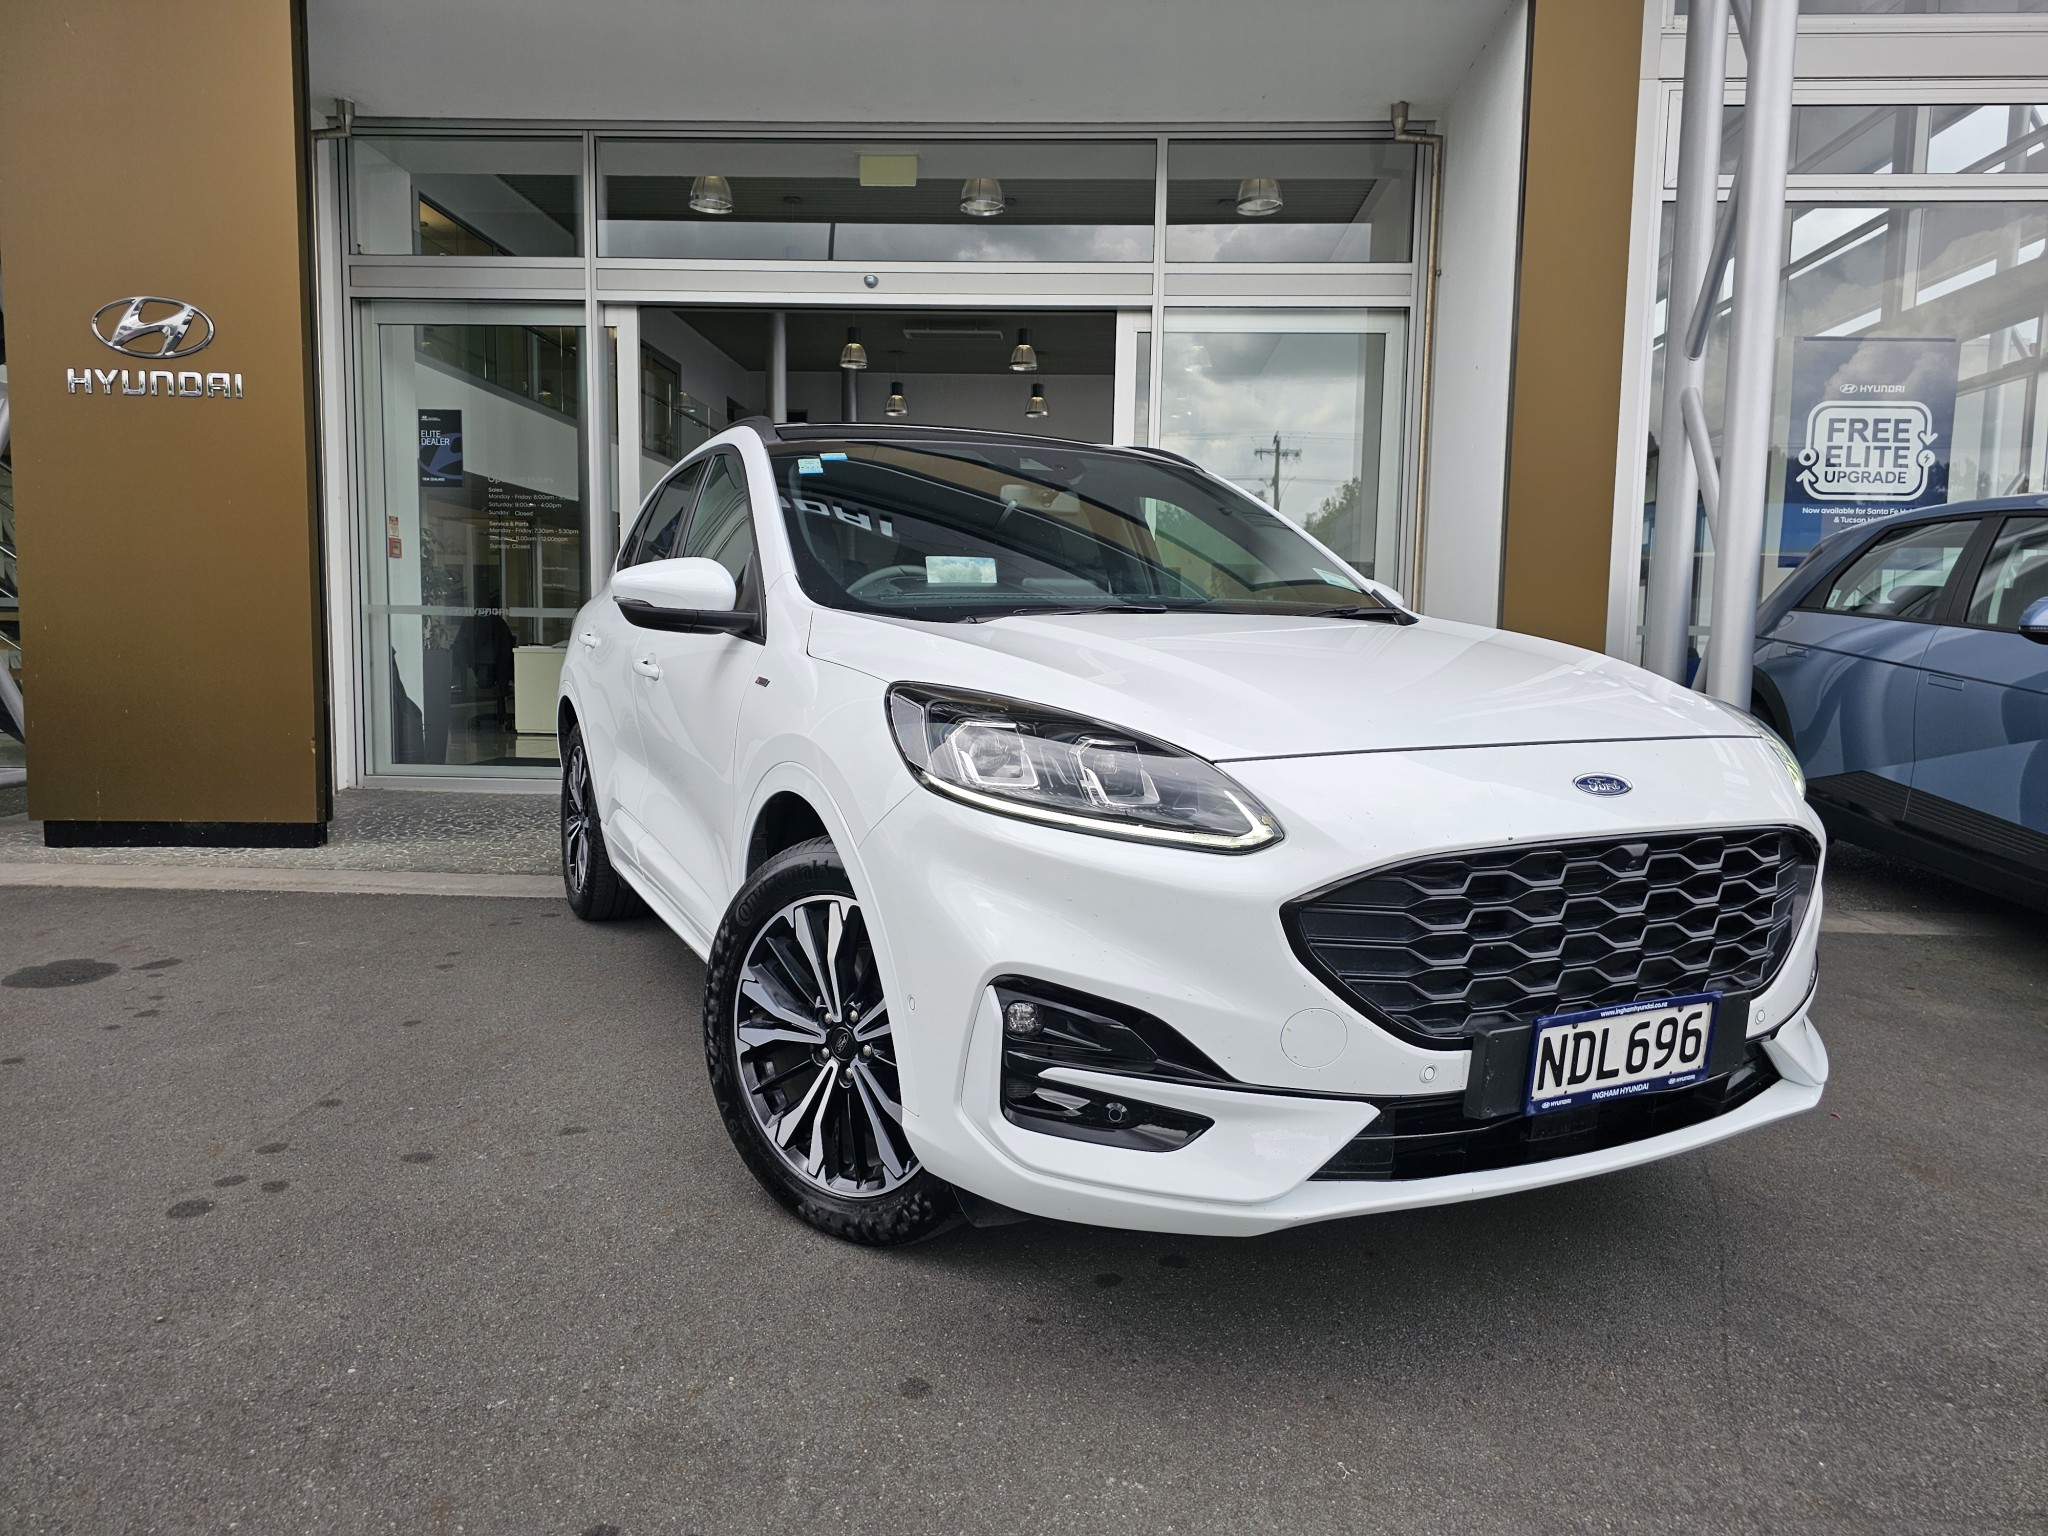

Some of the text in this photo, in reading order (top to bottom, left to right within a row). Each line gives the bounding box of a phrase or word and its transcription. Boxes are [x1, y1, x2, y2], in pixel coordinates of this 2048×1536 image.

[67, 368, 243, 398] HYUNDAI
[1860, 384, 1905, 393] HYUNDAI
[421, 430, 441, 438] ELITE
[1827, 418, 1912, 443] FREE
[421, 438, 450, 446] DEALER
[1825, 445, 1910, 468] ELITE
[1824, 470, 1907, 484] UPGRADE
[1867, 507, 1889, 515] Santa
[1841, 516, 1867, 524] Tucson
[1586, 777, 1621, 792] Ford
[1600, 1001, 1668, 1017] www.inghamhyundai.co.nz
[1537, 1011, 1703, 1091] NDL696
[1675, 1074, 1696, 1083] HYUNDAI
[1591, 1082, 1649, 1100] INGHAM HYUNDAI
[1550, 1098, 1572, 1107] HYUNDAI
